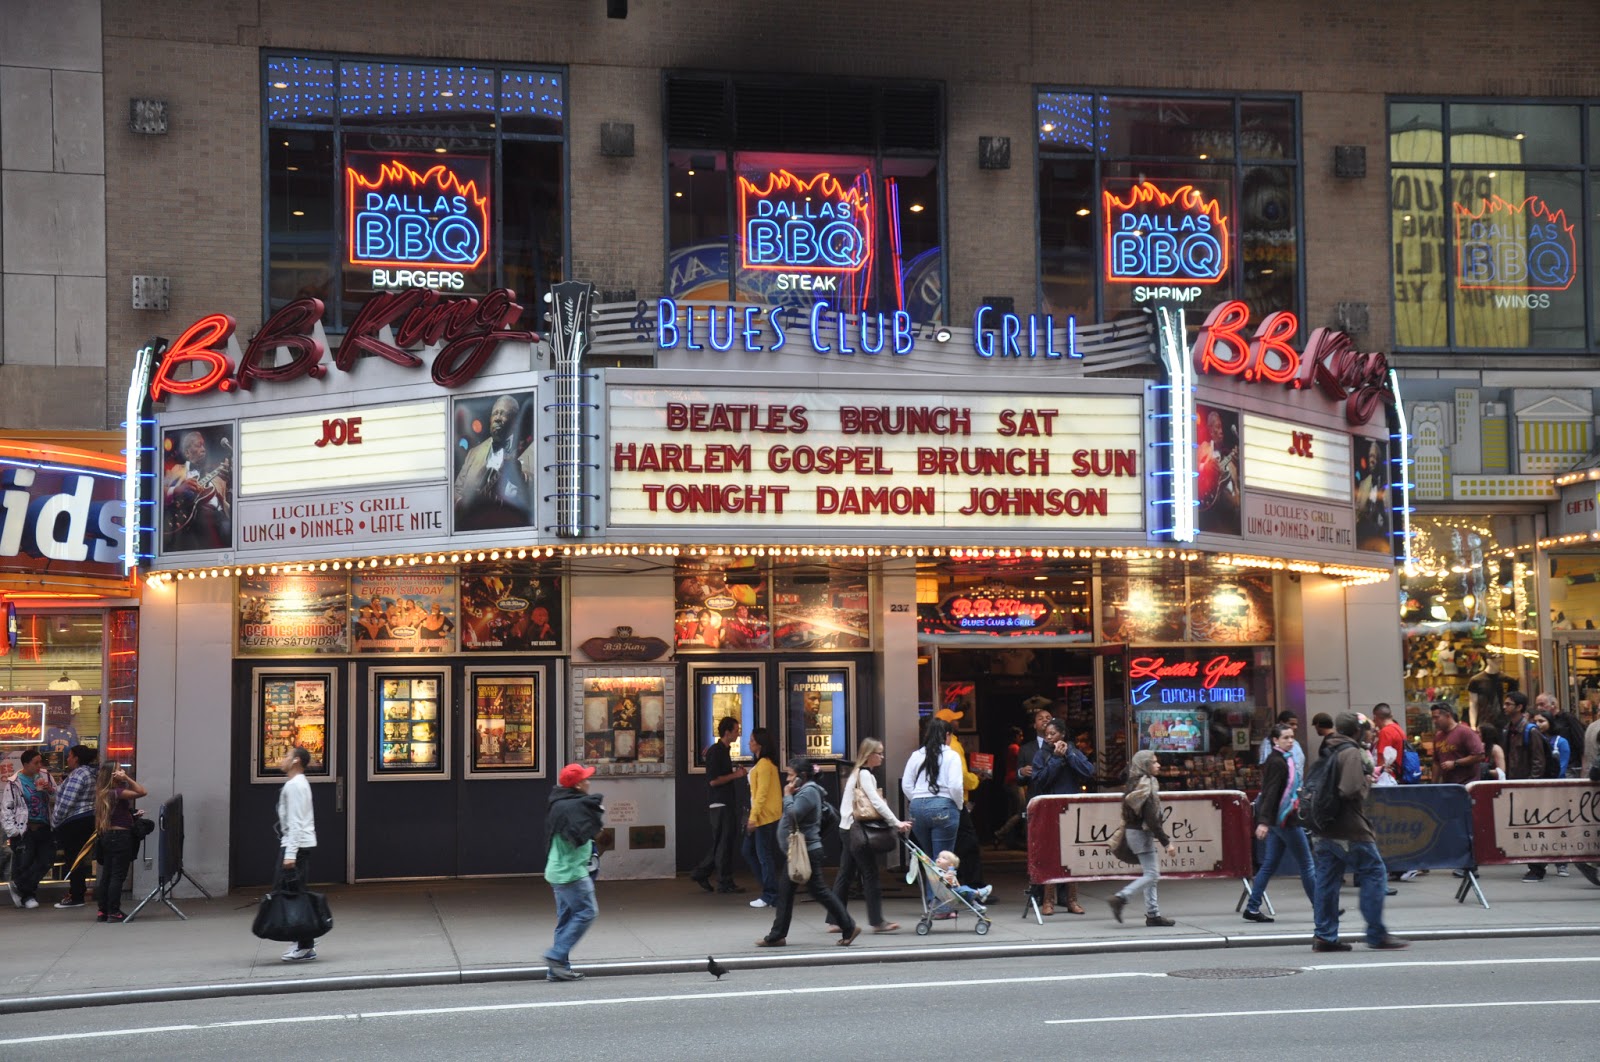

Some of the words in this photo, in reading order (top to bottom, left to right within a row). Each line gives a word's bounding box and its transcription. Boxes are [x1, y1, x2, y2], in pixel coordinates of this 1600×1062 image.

[366, 193, 467, 214] DALLAS
[758, 200, 851, 219] DALLAS
[1121, 212, 1211, 231] DALLAS
[356, 212, 480, 262] BBQ
[749, 218, 863, 266] BBQ
[1471, 223, 1558, 241] DALLAS
[1113, 231, 1222, 278] BBQ
[1463, 241, 1570, 284] BBQ
[372, 269, 465, 289] BURGERS
[777, 273, 836, 291] STEAK
[1134, 286, 1202, 302] SHRIMP
[1495, 293, 1550, 309] WINGS
[563, 296, 574, 336] Lucille
[336, 287, 540, 388] King
[657, 297, 786, 352] BLUES
[810, 301, 915, 355] CLUB
[973, 306, 1083, 359] GRILL
[1301, 326, 1396, 426] King
[667, 403, 809, 434] BEATLES
[840, 405, 971, 436] BRUNCH
[997, 408, 1058, 437] SAT
[314, 416, 362, 448] JOE
[1288, 430, 1313, 458] JOE
[614, 442, 751, 473] HARLEM
[767, 444, 893, 475] GOSPEL
[917, 447, 1049, 476] BRUNCH
[1071, 448, 1136, 478] SUN
[272, 500, 354, 520] LUCILLE'S
[360, 496, 410, 513] GRILL
[642, 483, 790, 513] TONIGHT
[816, 486, 935, 515] DAMON
[959, 487, 1108, 517] JOHNSON
[1567, 497, 1594, 516] GIFTS
[1264, 503, 1309, 521] LUCILLE'S
[1311, 510, 1336, 525] GRILL
[243, 521, 285, 543] LUNCH
[301, 516, 354, 539] DINNER
[371, 513, 405, 534] LATE
[410, 510, 442, 531] NITE
[1247, 516, 1272, 536] LUNCH
[1280, 522, 1309, 540] DINNER
[1316, 526, 1334, 544] LATE
[1336, 528, 1351, 546] NITE
[361, 586, 398, 595] EVERY
[400, 586, 444, 595] SUNDAY
[890, 604, 909, 612] 237
[961, 619, 985, 627] BLUES
[985, 618, 1006, 626] CLUB
[1006, 618, 1014, 626] &
[1014, 618, 1036, 627] GRILL
[246, 637, 281, 646] EVERY
[283, 637, 339, 646] SATURDAY
[702, 676, 752, 684] APPEARING
[716, 684, 738, 693] NEXT
[793, 683, 843, 692] APPEARING
[807, 736, 830, 747] JOE
[1237, 732, 1247, 744] B
[1075, 806, 1198, 843] Lule's
[1513, 831, 1545, 839] BAR
[1079, 848, 1111, 856] BAR
[1523, 842, 1567, 851] LUNCH
